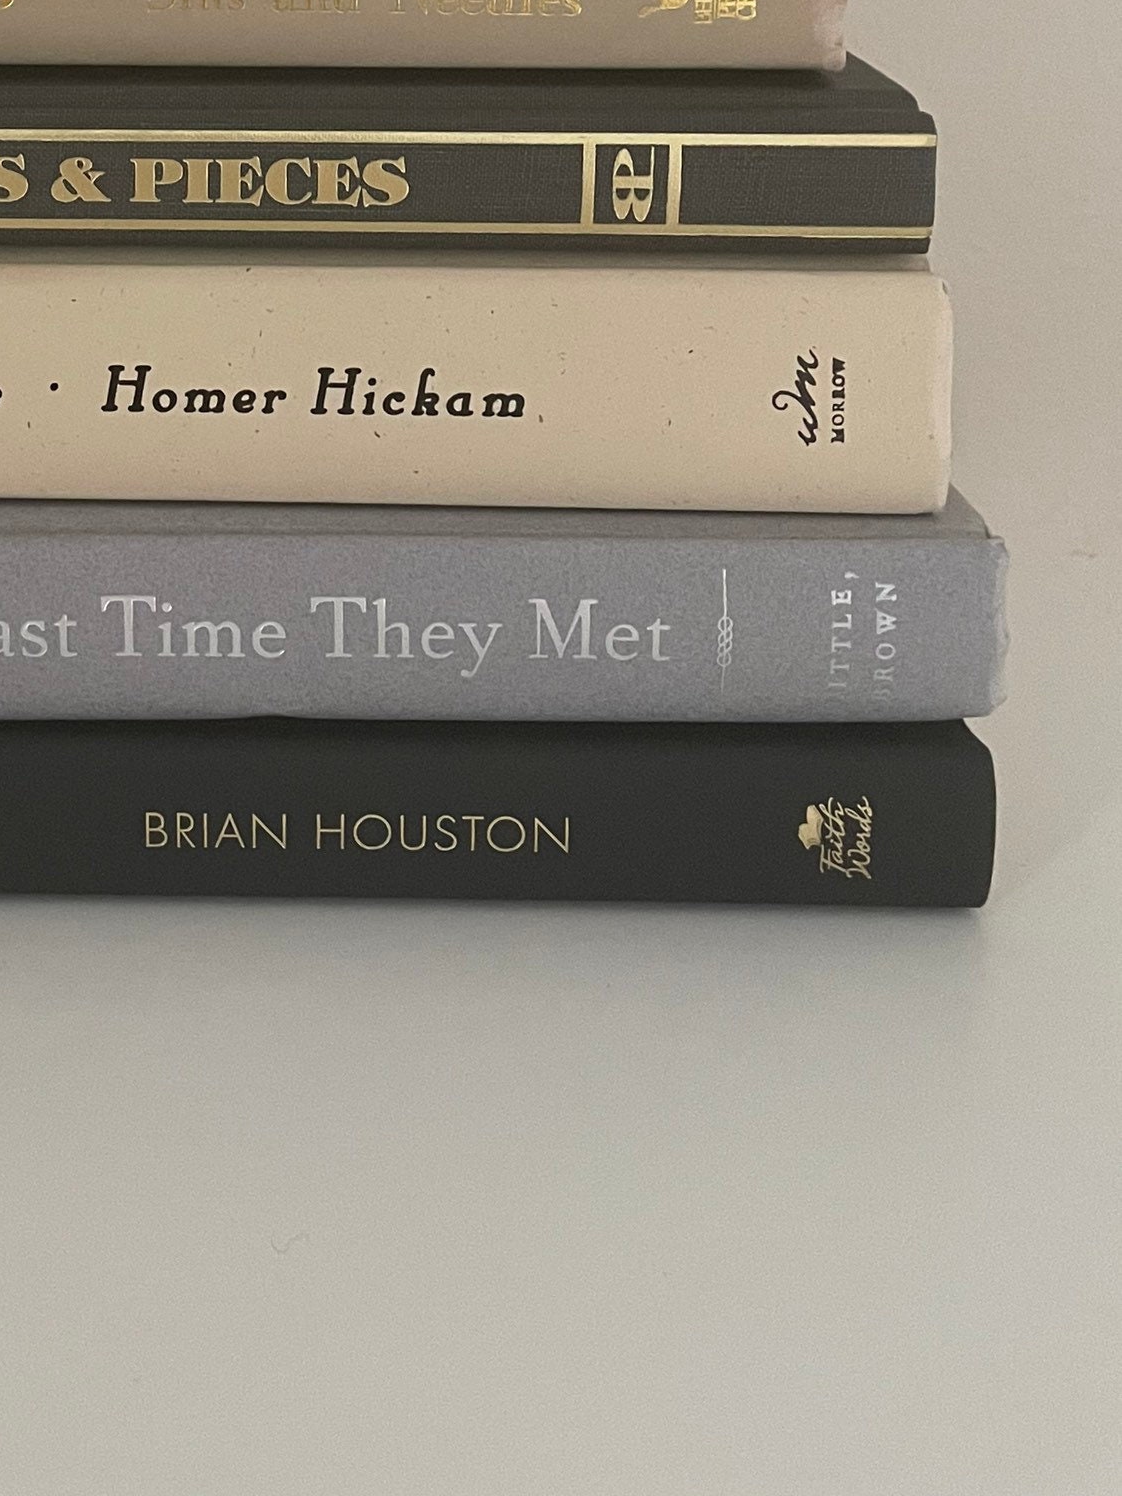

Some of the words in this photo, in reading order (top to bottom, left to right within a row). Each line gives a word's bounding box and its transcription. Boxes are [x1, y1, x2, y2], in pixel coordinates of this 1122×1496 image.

[49, 155, 112, 204] &
[128, 154, 411, 208] PIECES
[99, 364, 287, 415] Homer
[309, 367, 526, 419] Hickam
[830, 356, 847, 444] MORROW
[99, 594, 288, 660] Time
[309, 595, 504, 679] They
[527, 597, 672, 663] Met
[143, 811, 288, 850] BRIAN
[314, 813, 572, 854] HOUSTON
